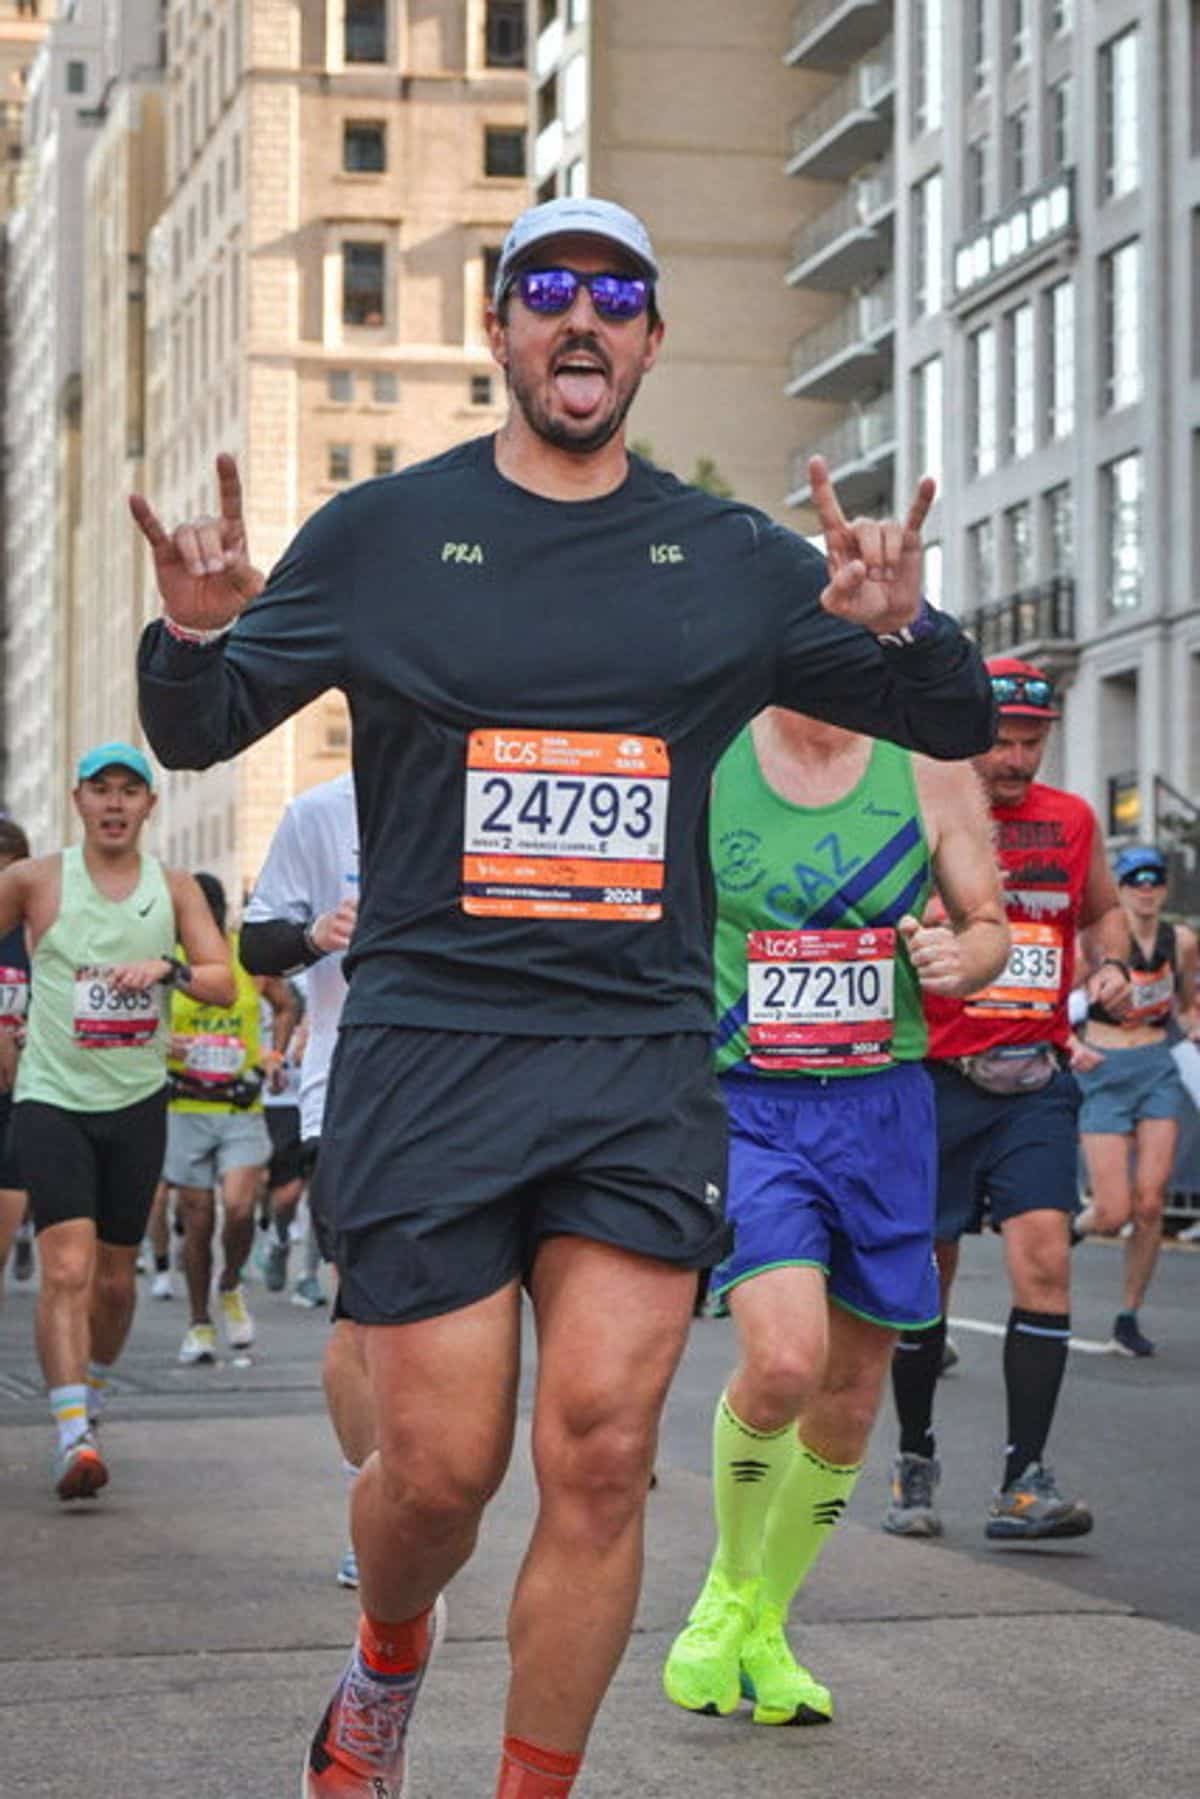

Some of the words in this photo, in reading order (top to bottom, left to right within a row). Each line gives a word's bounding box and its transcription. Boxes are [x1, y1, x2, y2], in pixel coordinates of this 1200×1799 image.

[441, 542, 484, 564] PRA
[494, 735, 538, 765] tcs
[481, 778, 653, 839] 24793
[604, 887, 643, 904] 2024
[1008, 947, 1057, 979] 835
[763, 964, 881, 1008] 27210
